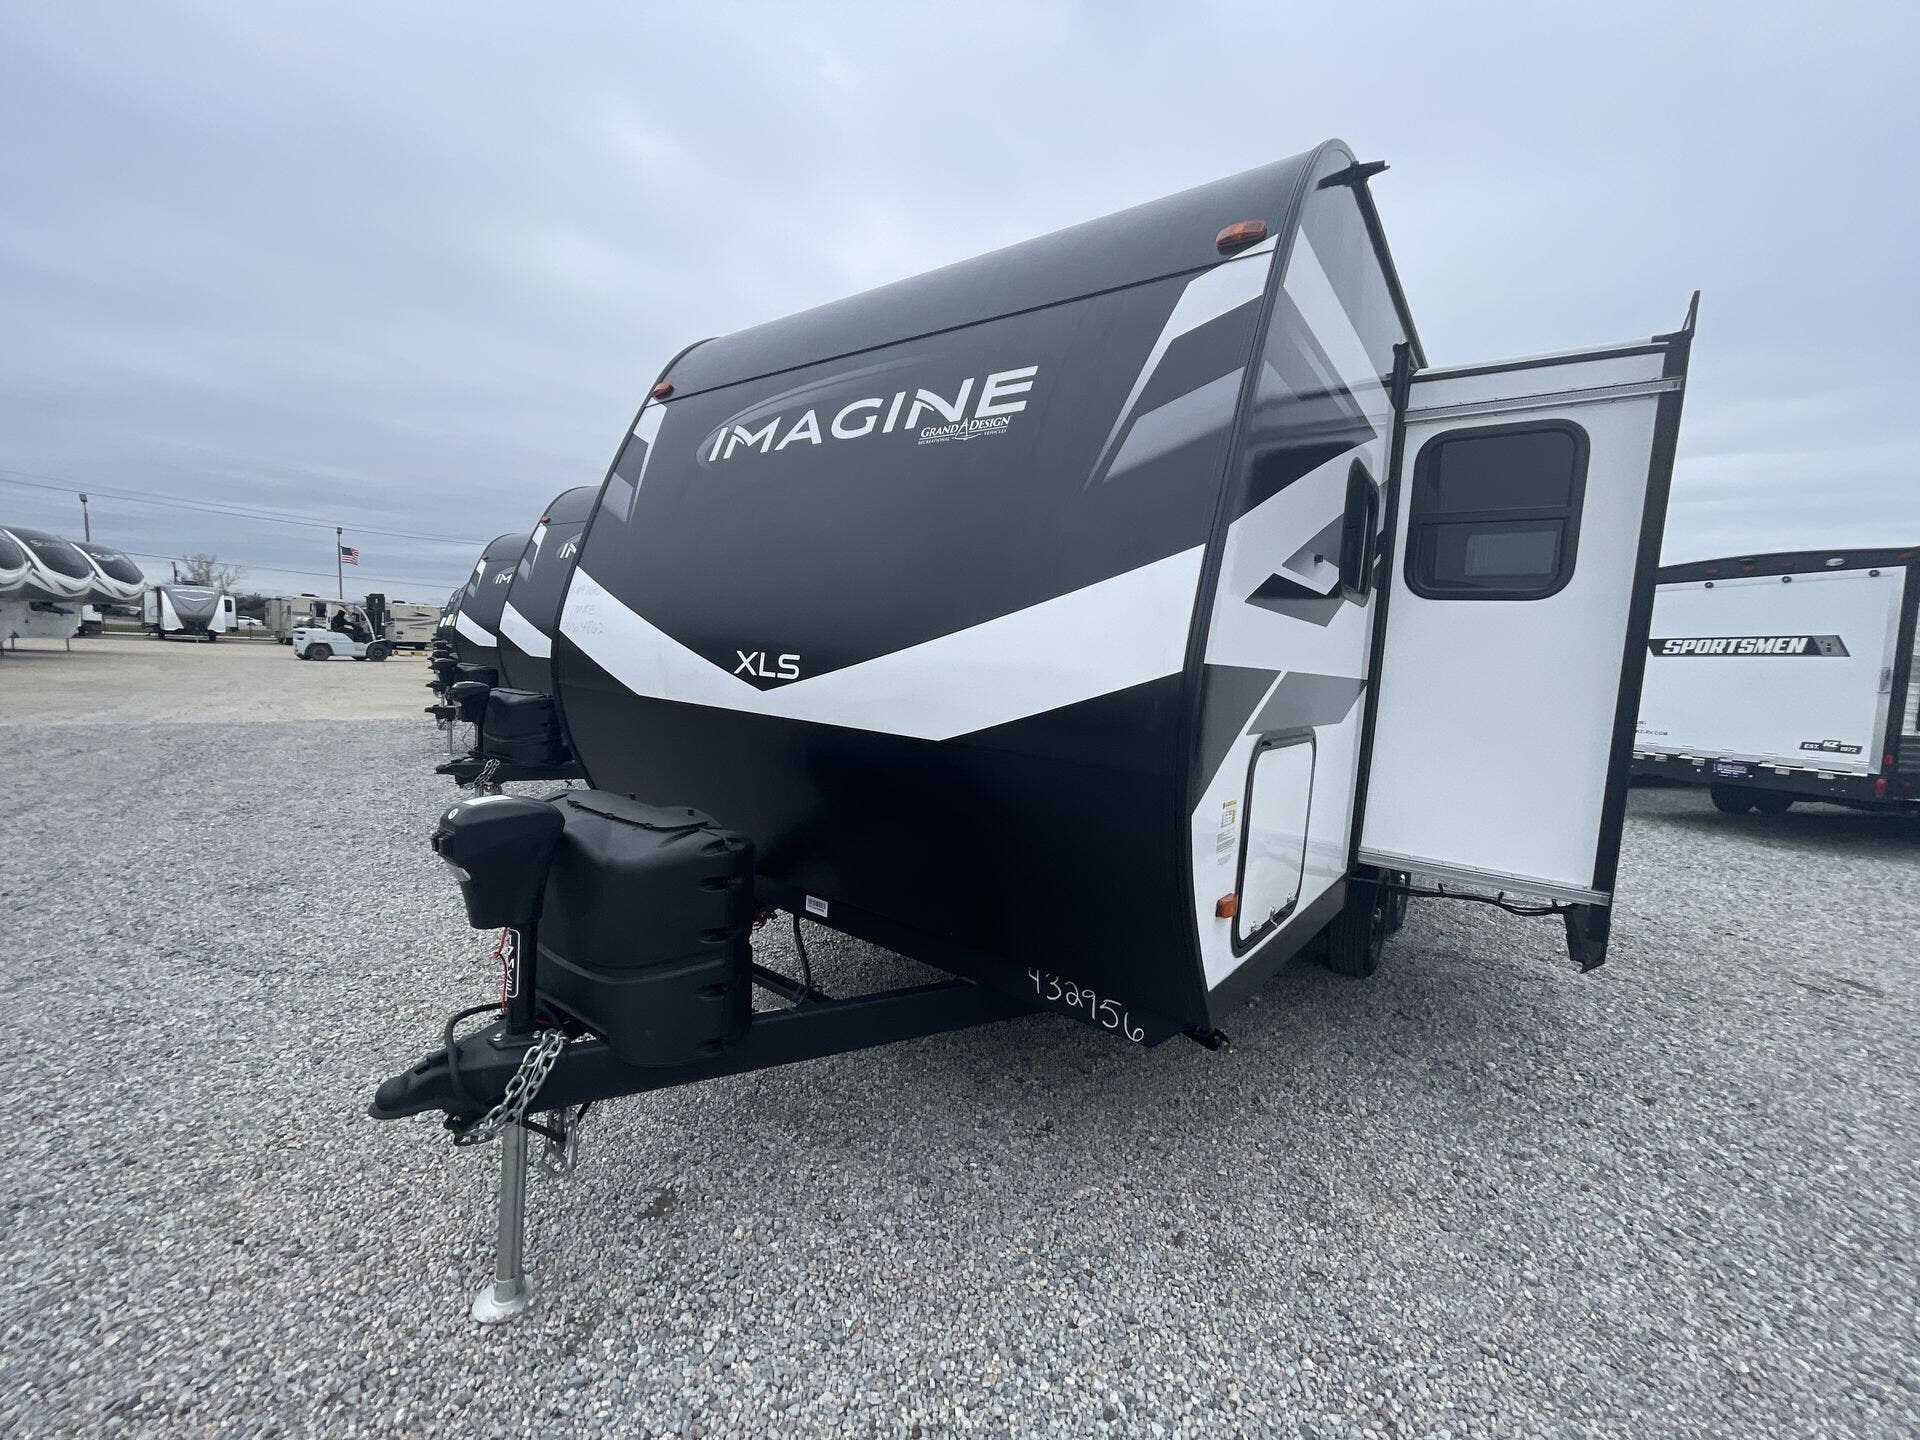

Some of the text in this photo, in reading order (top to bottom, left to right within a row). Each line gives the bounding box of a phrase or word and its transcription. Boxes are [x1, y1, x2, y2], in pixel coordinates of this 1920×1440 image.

[708, 365, 1039, 462] IMAGINE
[920, 416, 1011, 437] GRAND DESIGN
[1662, 638, 1809, 654] SPORTSMEN
[733, 650, 801, 680] XLS
[1027, 966, 1145, 1042] 432956
